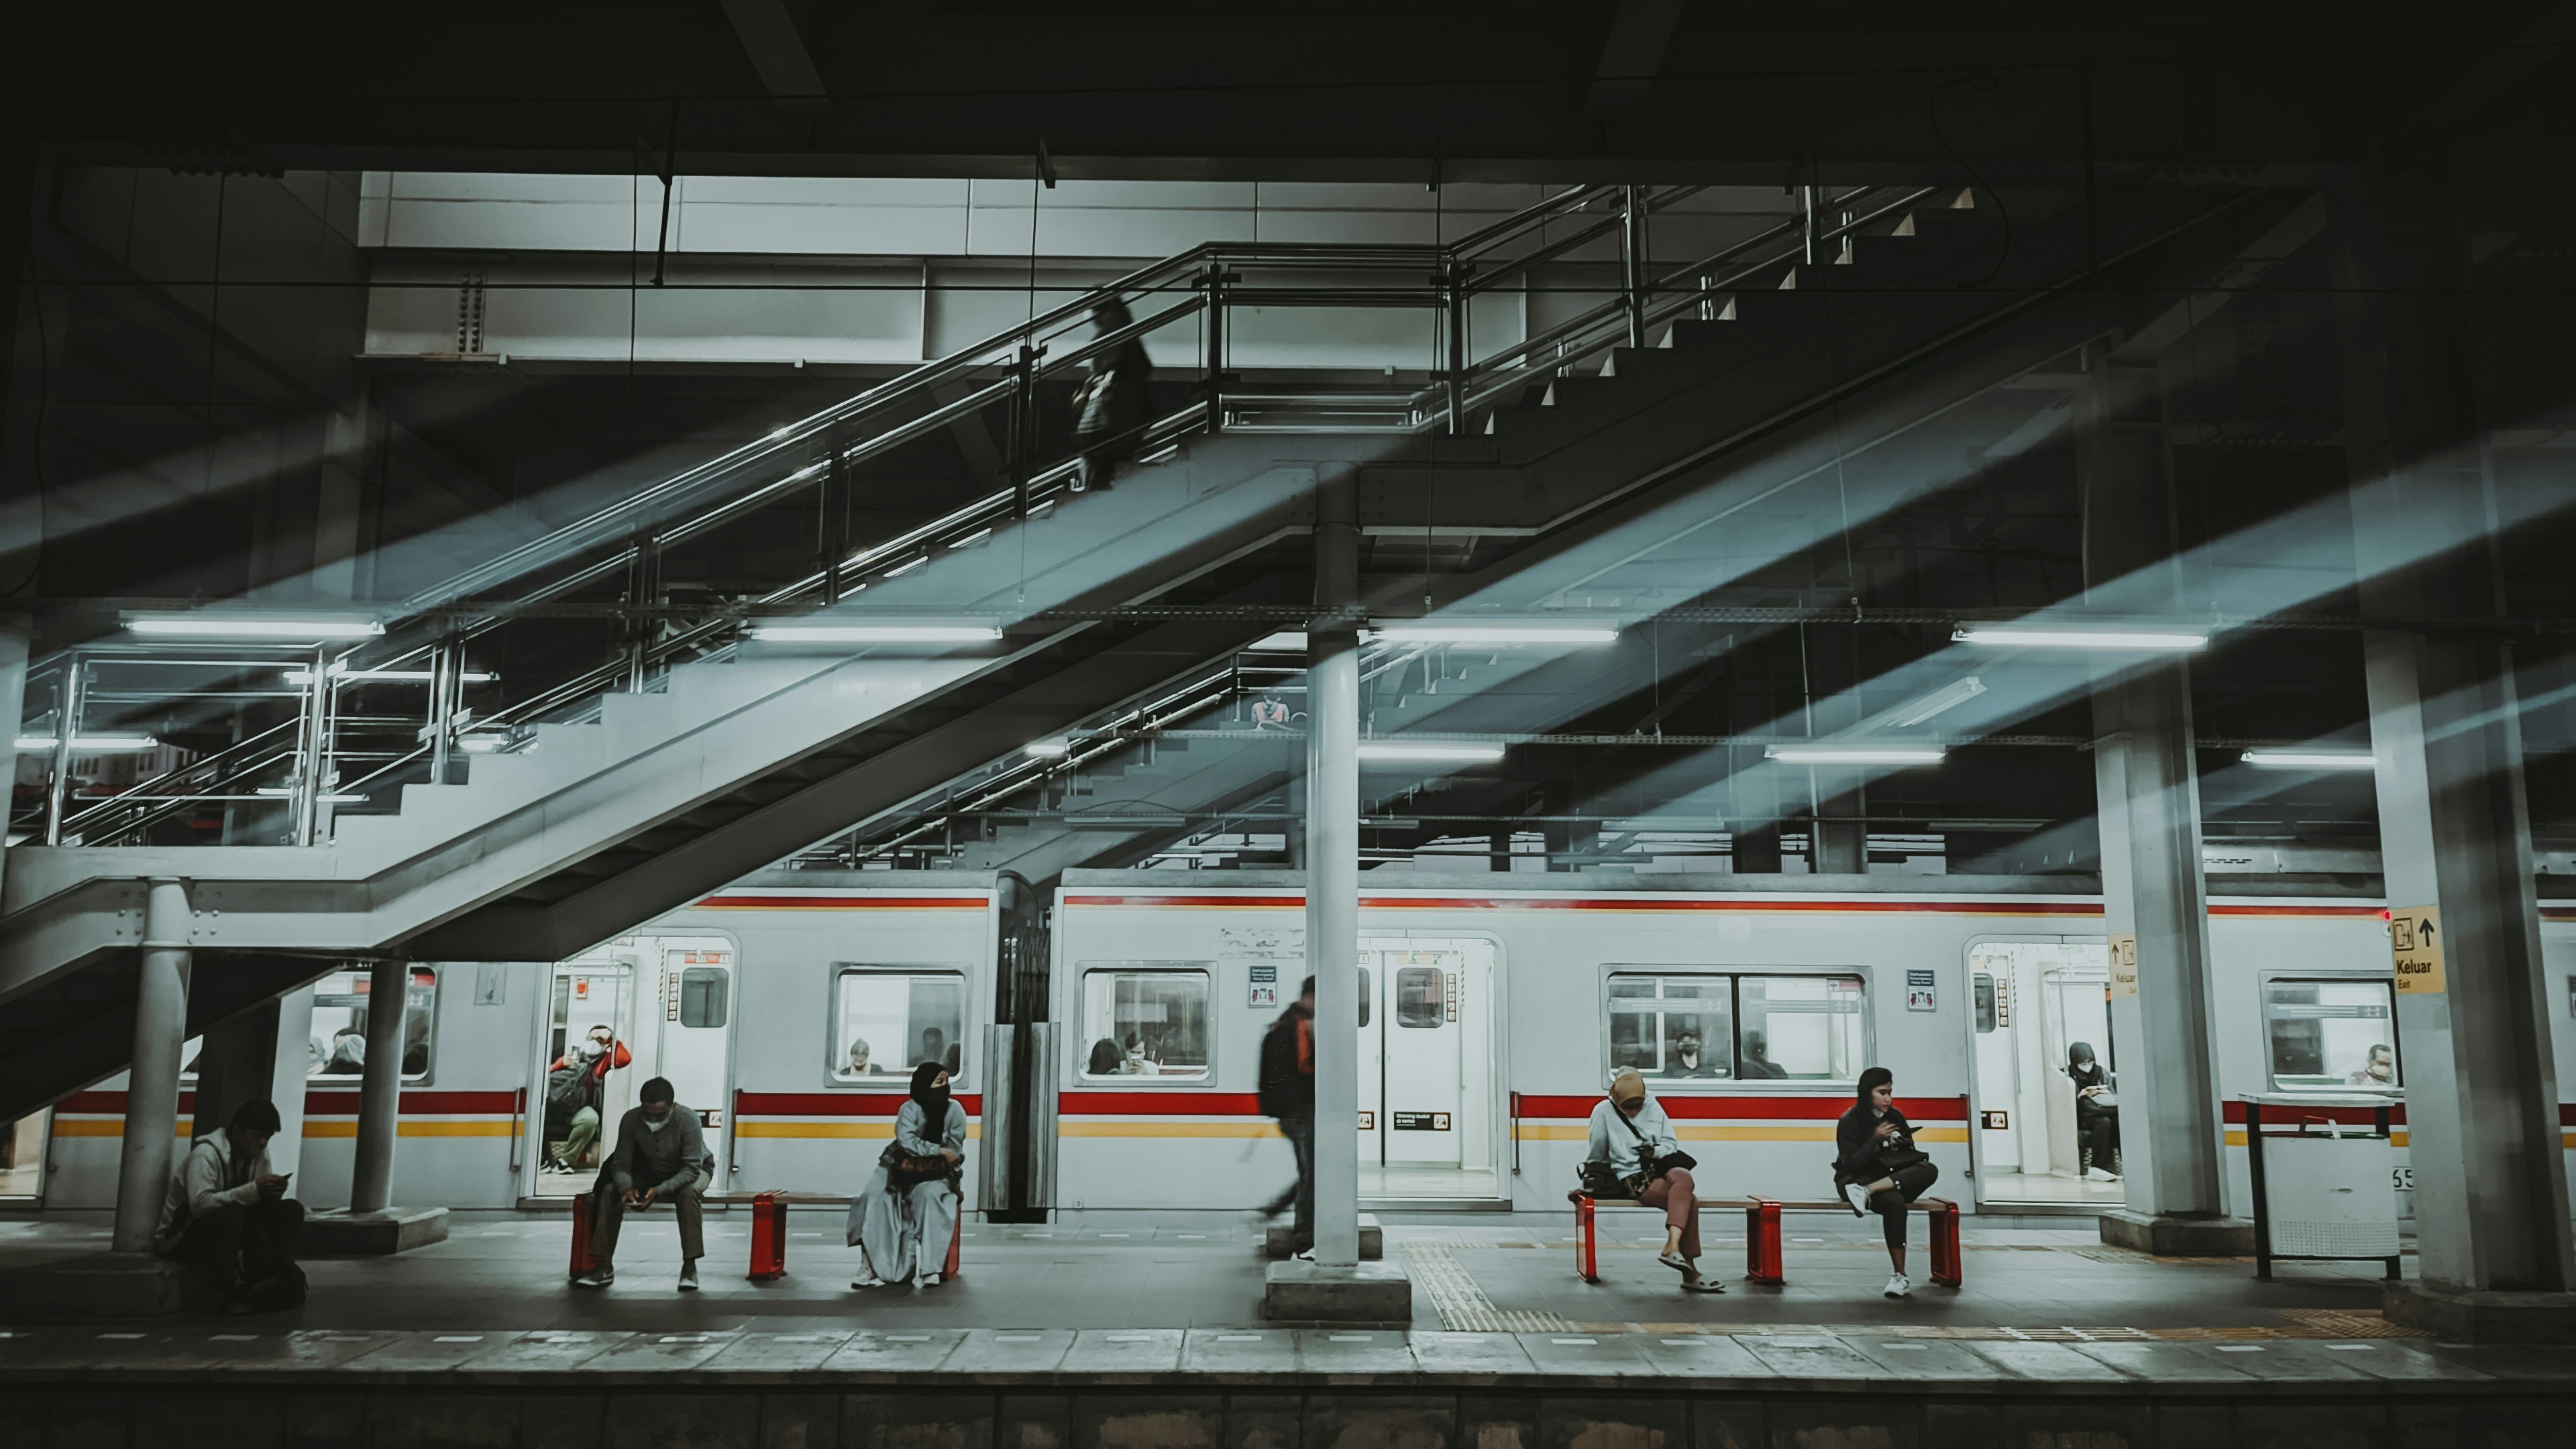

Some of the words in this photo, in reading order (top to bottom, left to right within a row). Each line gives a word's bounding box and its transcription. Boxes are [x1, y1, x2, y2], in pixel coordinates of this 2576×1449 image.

[2396, 959, 2432, 974] Keluar
[2116, 973, 2136, 983] Keluar
[2398, 979, 2410, 989] Exit
